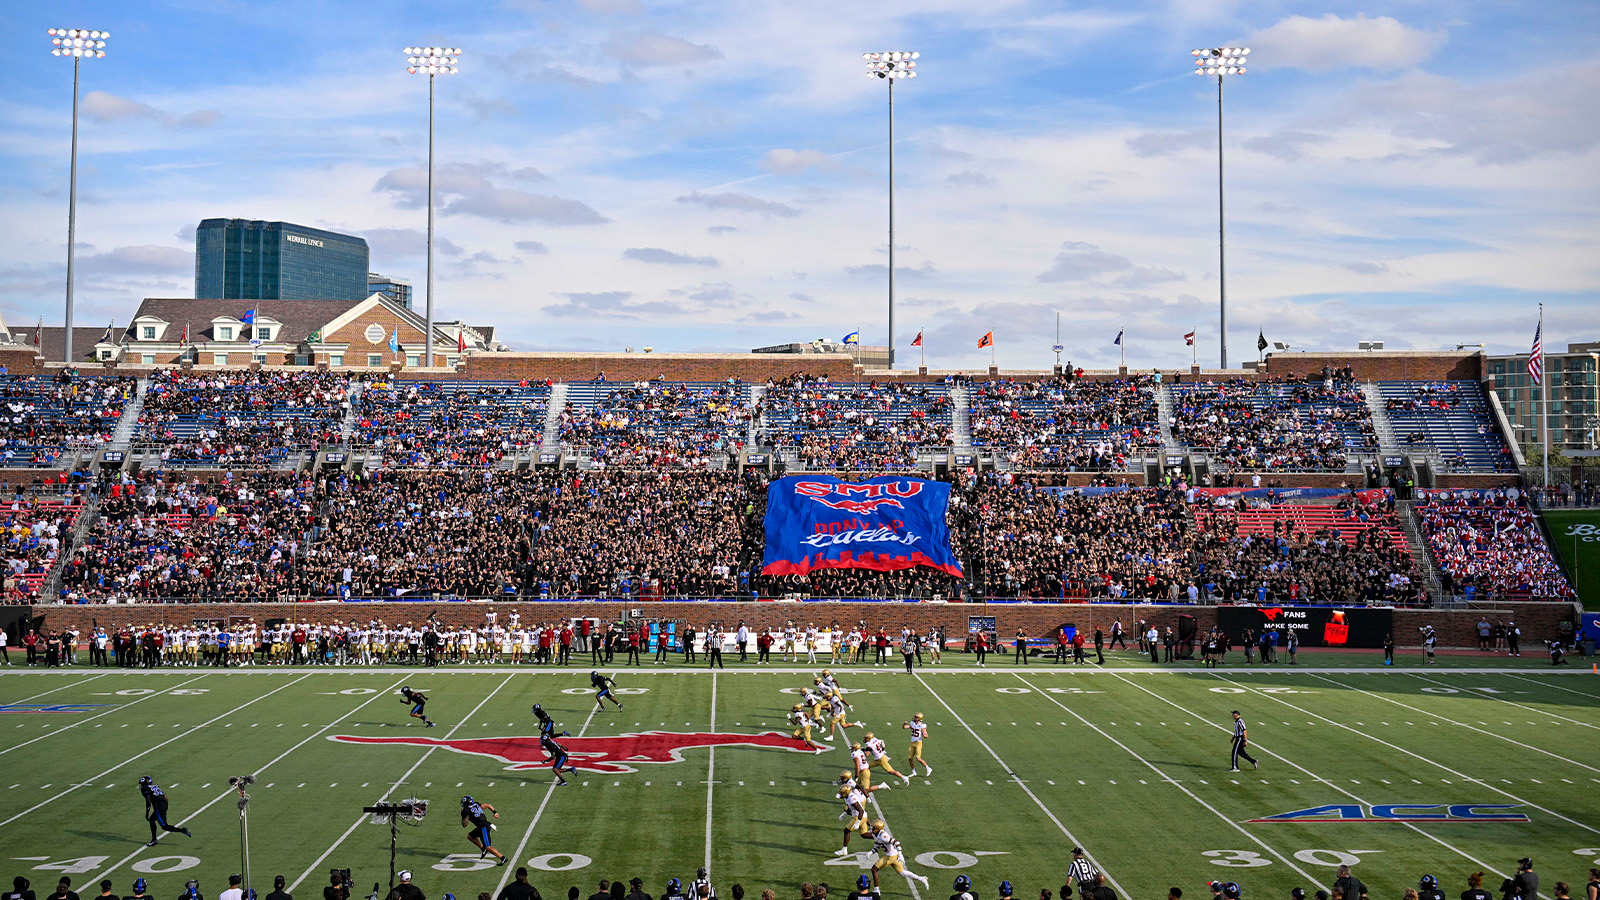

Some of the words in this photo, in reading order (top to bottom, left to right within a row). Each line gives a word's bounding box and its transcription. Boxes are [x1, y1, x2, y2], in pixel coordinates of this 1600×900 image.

[794, 481, 925, 498] SMU
[1250, 804, 1529, 820] ACC
[1080, 862, 1089, 873] B
